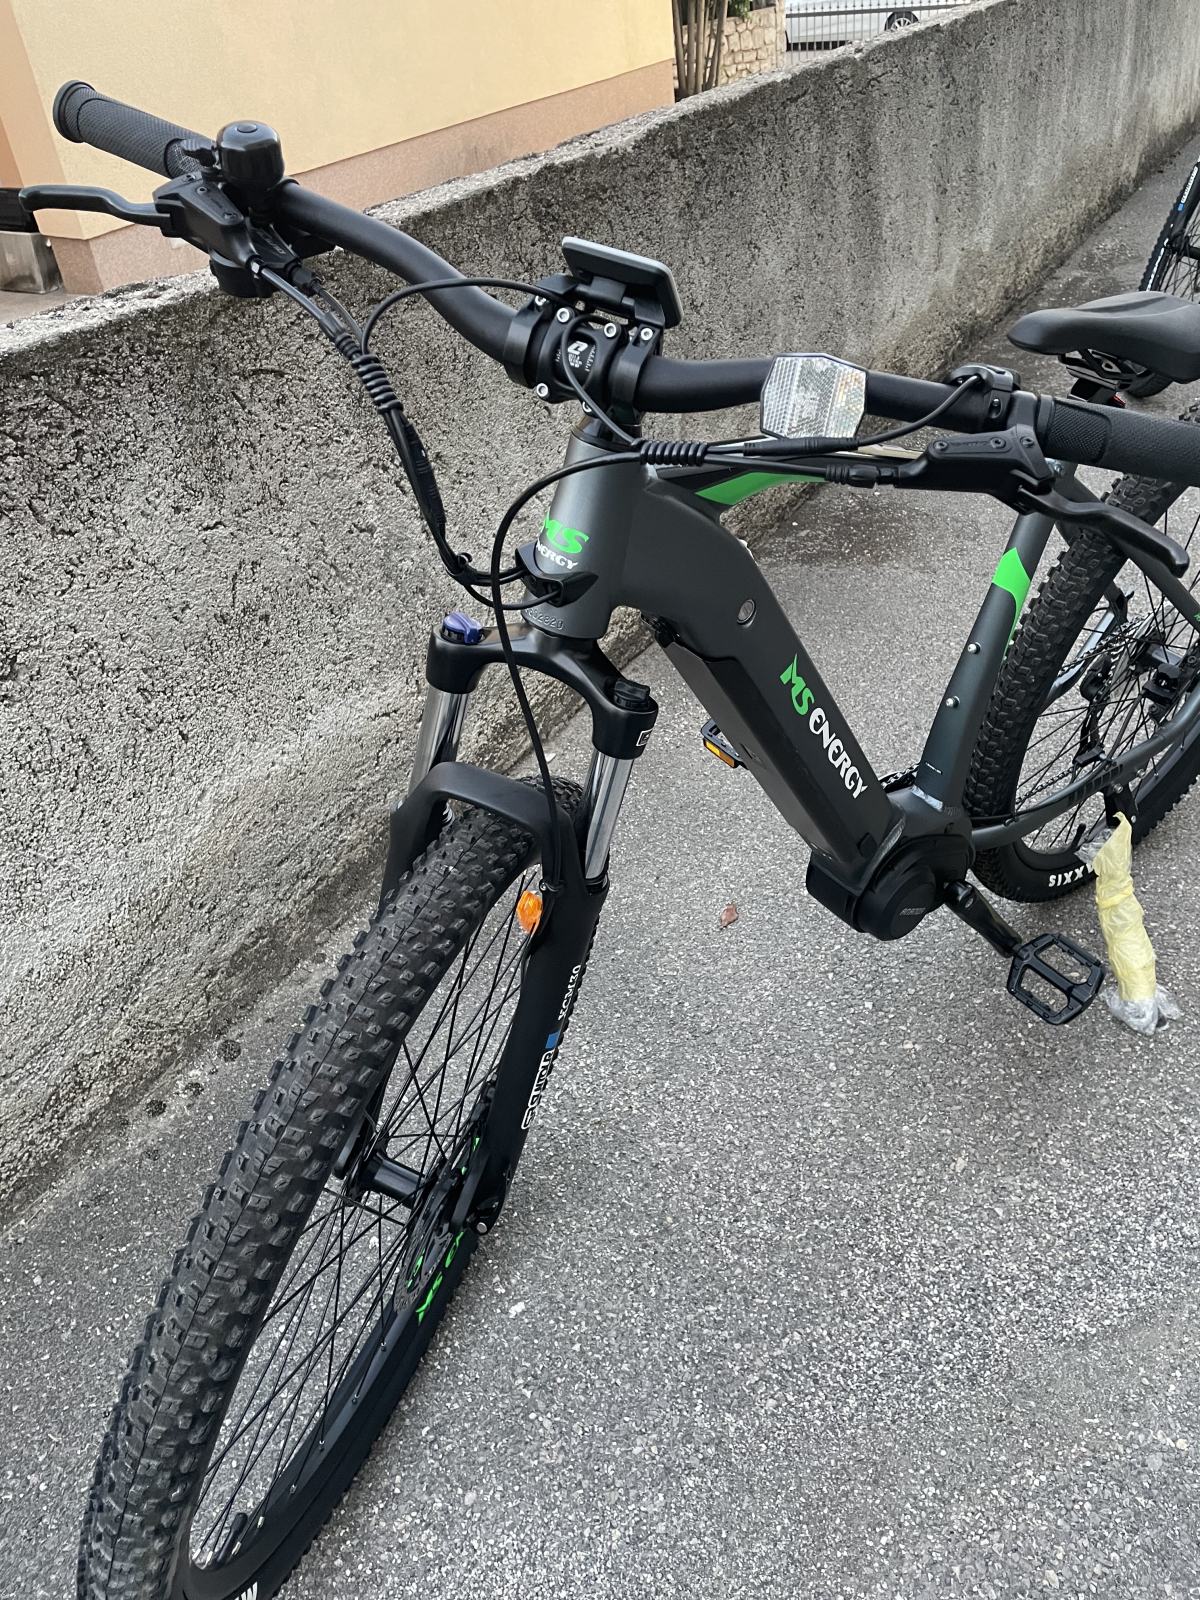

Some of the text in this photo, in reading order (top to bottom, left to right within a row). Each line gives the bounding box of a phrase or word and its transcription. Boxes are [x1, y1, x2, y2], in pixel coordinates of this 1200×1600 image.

[536, 538, 578, 570] NERGY
[779, 653, 869, 799] MS ENERGY
[1048, 863, 1094, 887] AXXIS
